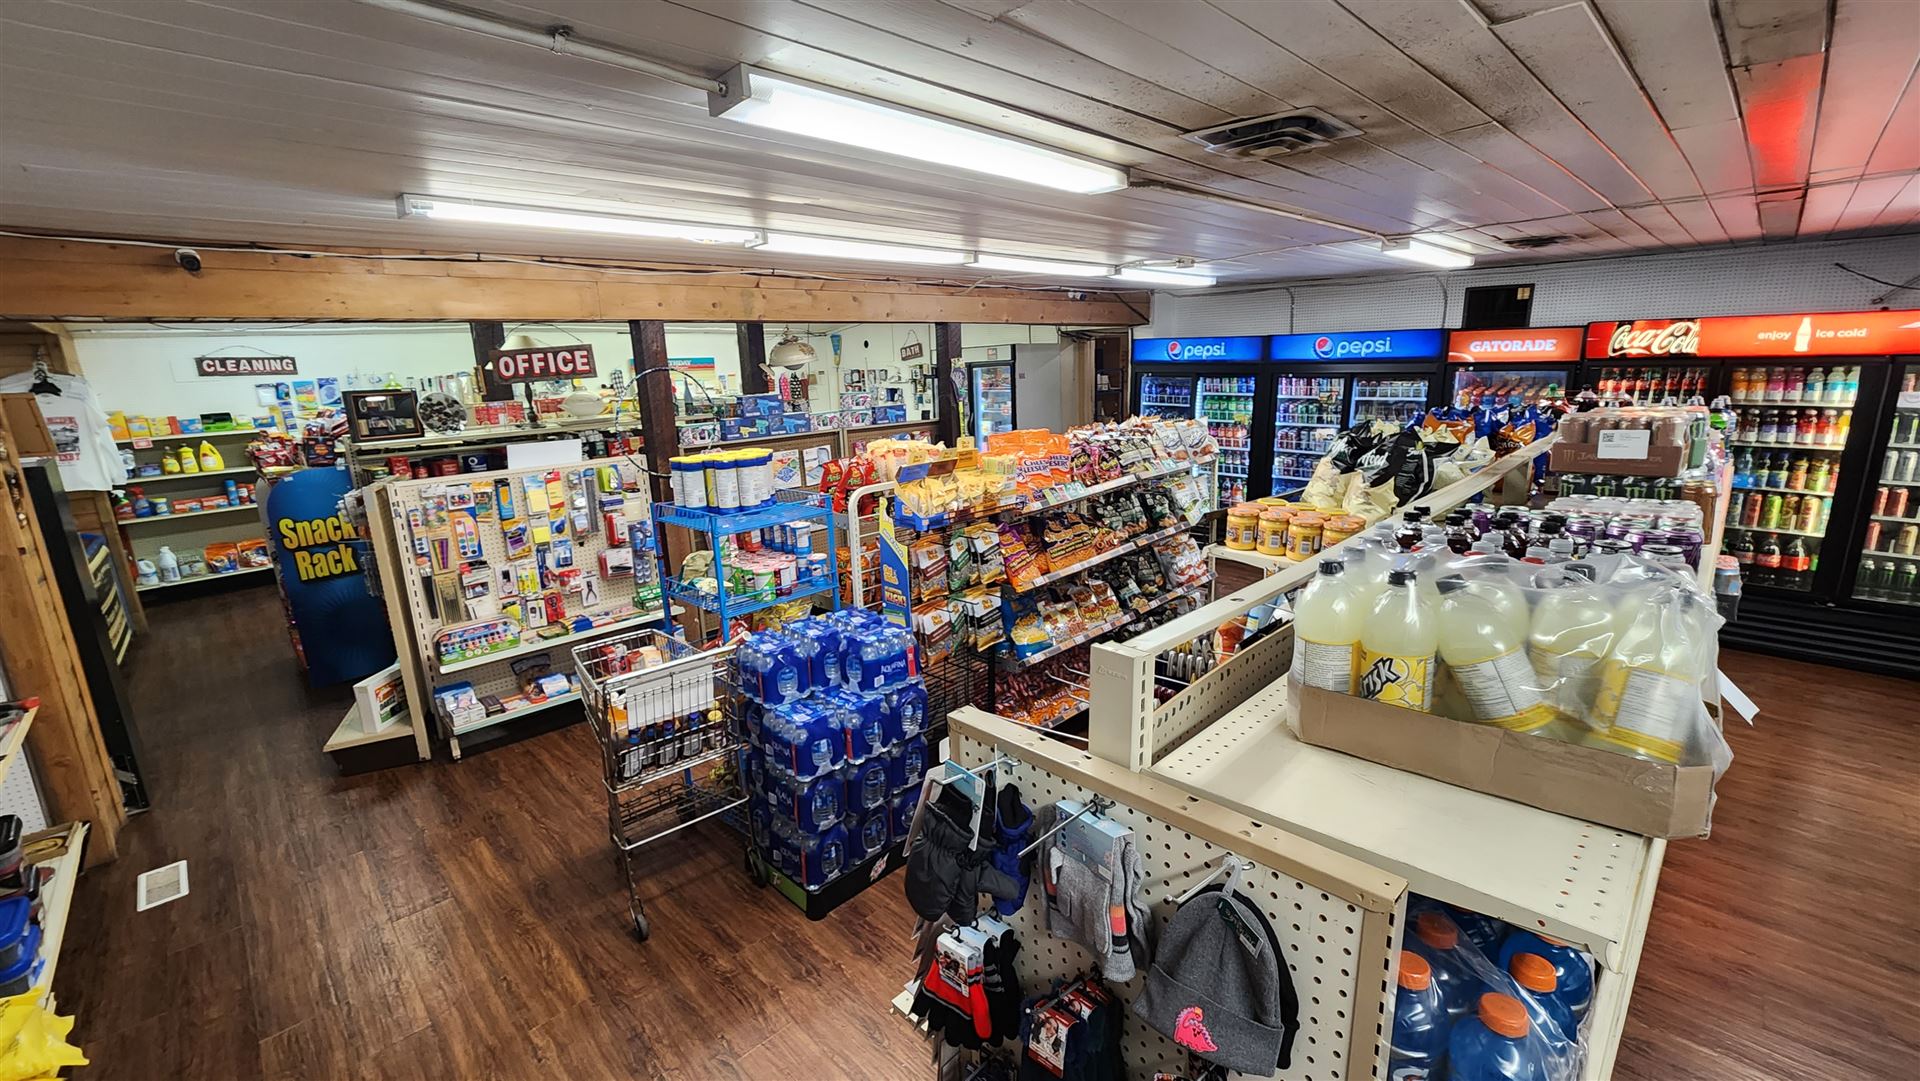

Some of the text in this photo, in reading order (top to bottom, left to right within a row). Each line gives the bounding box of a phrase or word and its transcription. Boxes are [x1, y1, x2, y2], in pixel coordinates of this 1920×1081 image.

[1608, 321, 1699, 356] Coca-Cola
[1758, 326, 1792, 340] enjoy
[1816, 323, 1868, 338] ice cold
[901, 345, 920, 358] BATH
[1184, 342, 1226, 360] pepsi
[1337, 336, 1392, 357] pepsi
[1469, 339, 1558, 353] GATORADE
[202, 358, 294, 373] CLEANING
[498, 350, 592, 380] OFFICE
[279, 512, 357, 549] Snack
[295, 544, 357, 580] Rack
